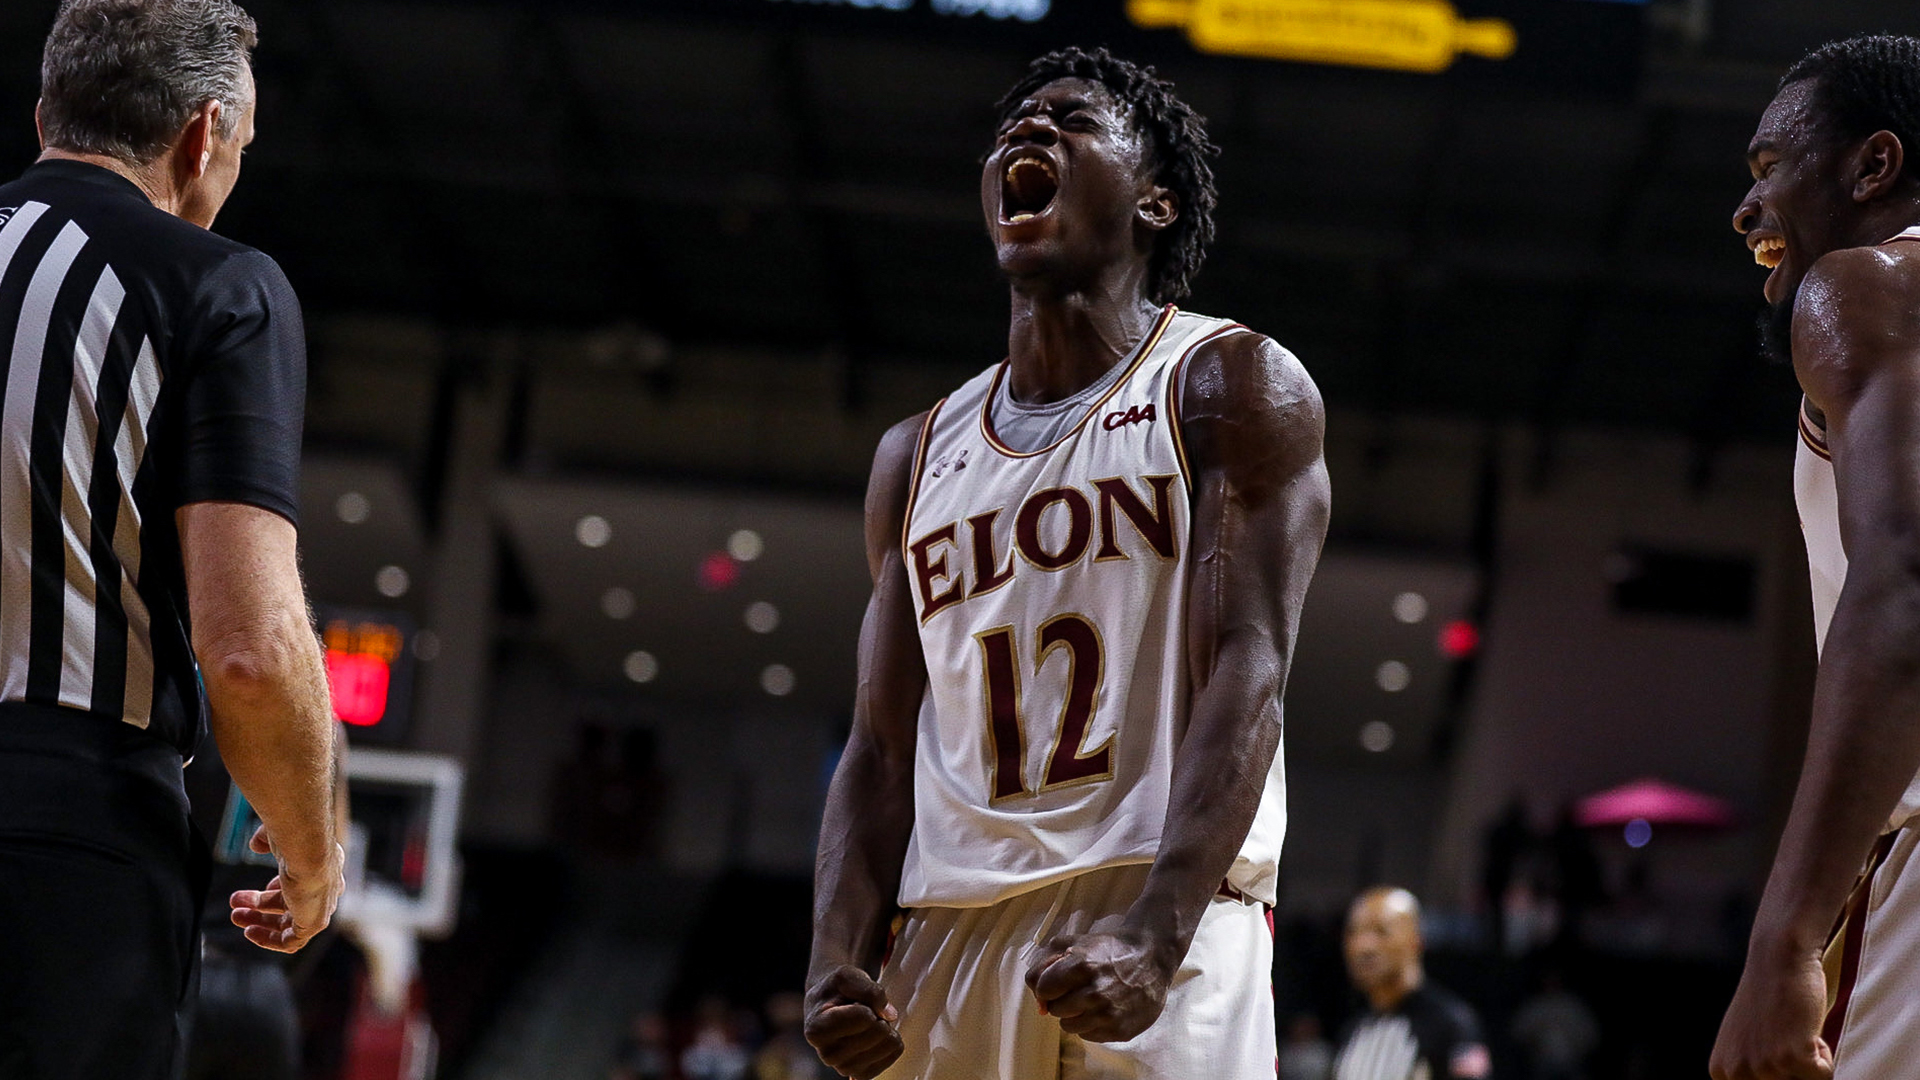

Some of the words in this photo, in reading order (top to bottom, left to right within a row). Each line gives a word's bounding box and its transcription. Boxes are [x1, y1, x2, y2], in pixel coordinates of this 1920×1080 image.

[1103, 403, 1156, 431] CAA
[908, 474, 1179, 627] ELON
[973, 613, 1117, 807] 12
